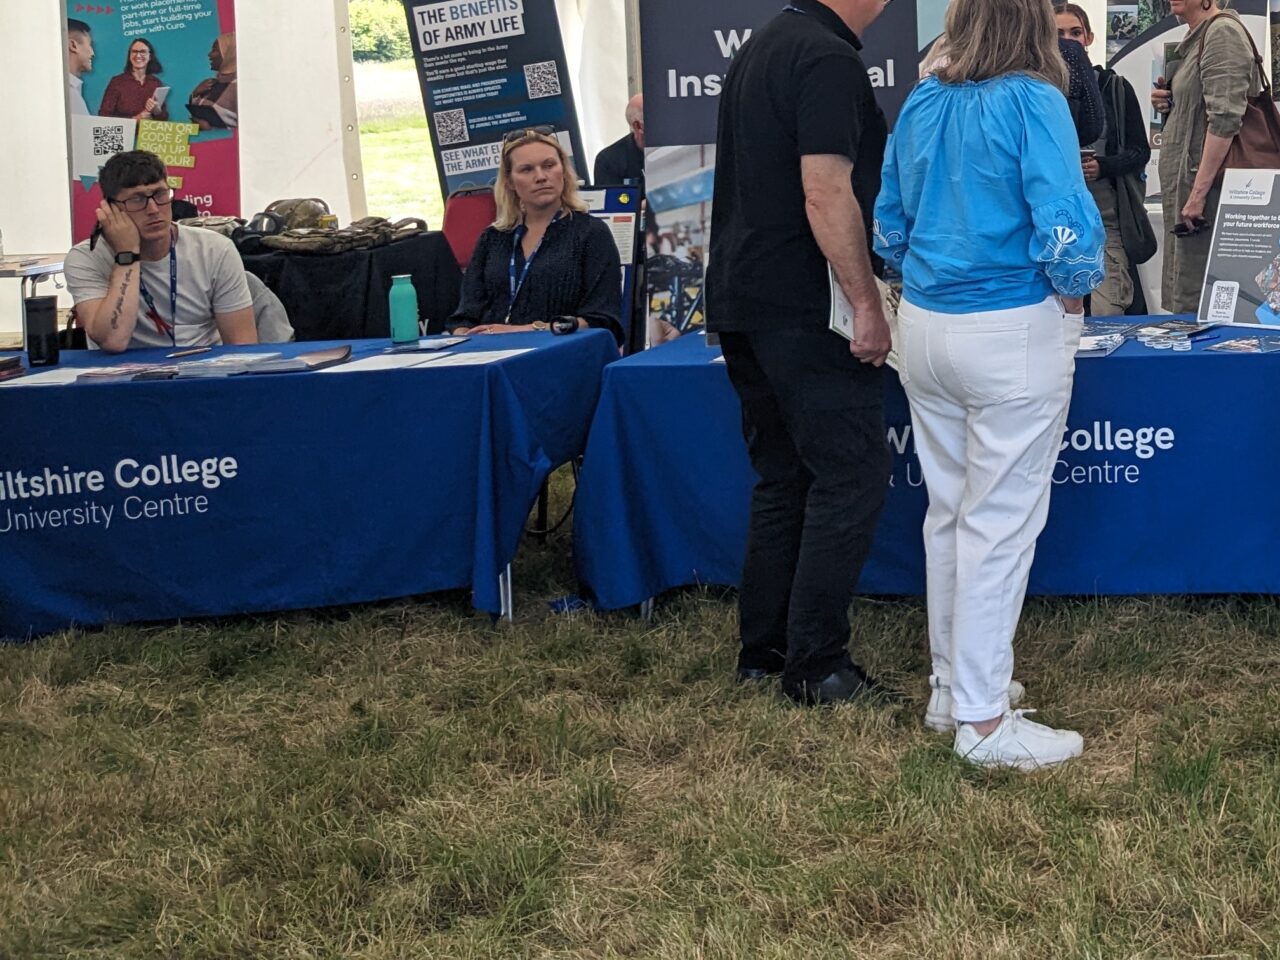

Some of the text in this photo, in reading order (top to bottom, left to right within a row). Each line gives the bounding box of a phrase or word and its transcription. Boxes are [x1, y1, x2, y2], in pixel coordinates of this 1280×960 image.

[122, 8, 157, 21] part-time
[169, 3, 201, 13] full-time
[131, 2, 149, 10] work
[123, 10, 212, 30] jobs, start building your
[418, 8, 447, 26] THE
[124, 28, 147, 36] career
[150, 25, 165, 33] with
[422, 16, 519, 46] OF ARMY LIFE
[142, 121, 172, 132] SCAN
[141, 132, 170, 142] CODE
[140, 143, 186, 154] SIGN UP
[443, 151, 461, 161] SEE
[462, 147, 489, 159] WHAT
[168, 155, 191, 166] OUR
[445, 161, 463, 173] THE
[465, 157, 491, 170] ARMY
[1225, 213, 1246, 221] Working
[1247, 214, 1270, 222] together
[1236, 220, 1252, 228] future
[0, 455, 238, 500] iltshire College
[1051, 460, 1140, 483] Centre
[124, 493, 208, 520] Centre
